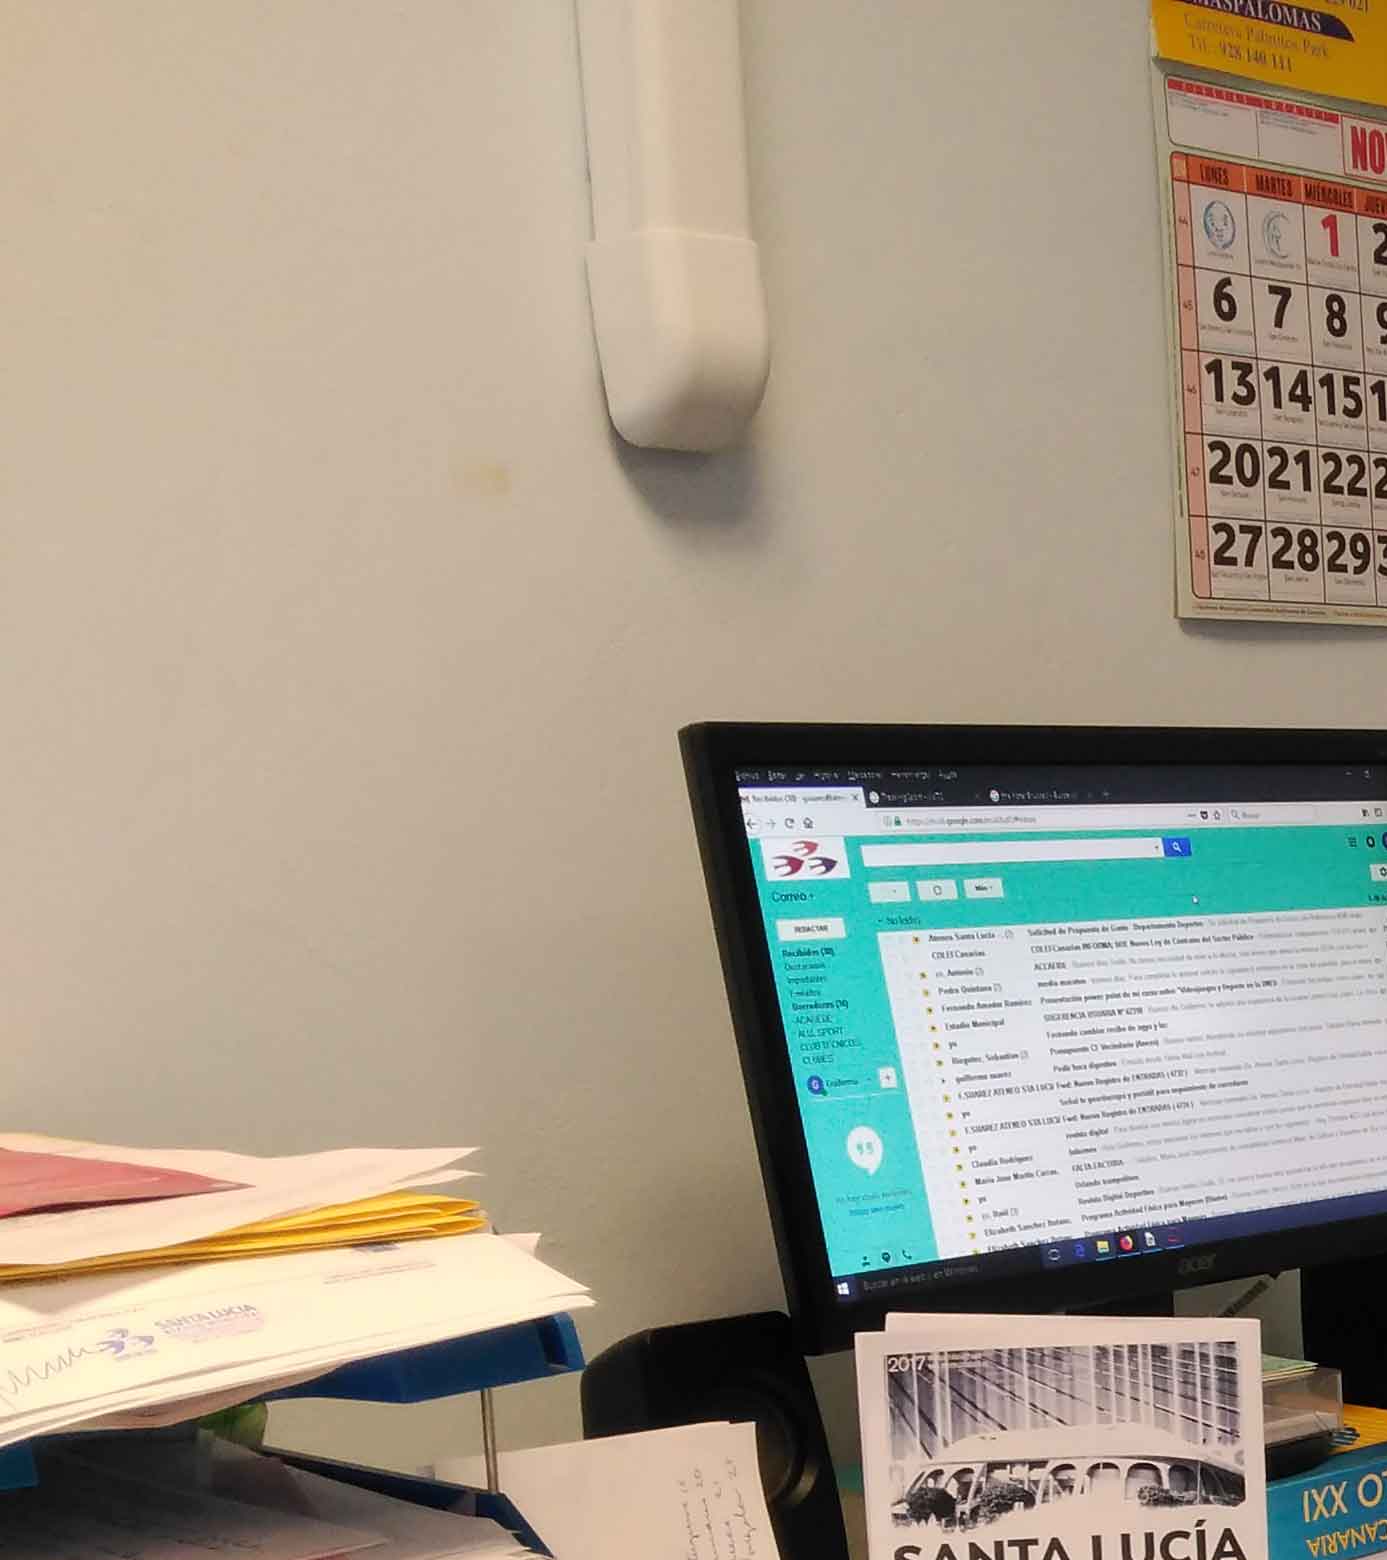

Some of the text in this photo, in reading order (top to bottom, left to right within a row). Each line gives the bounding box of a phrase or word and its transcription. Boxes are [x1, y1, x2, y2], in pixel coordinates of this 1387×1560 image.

[1200, 163, 1230, 186] LUNES
[1255, 174, 1293, 198] MARTES
[1321, 214, 1340, 257] 1
[1213, 277, 1237, 322] 6
[1268, 284, 1292, 329] 7
[1325, 293, 1348, 338] 8
[1204, 358, 1256, 406] 13
[1263, 366, 1313, 413] 14
[1318, 372, 1363, 418] 15
[1207, 440, 1261, 488] 20
[1266, 446, 1312, 492] 21
[1321, 451, 1368, 497] 22
[1212, 522, 1263, 568] 27
[1270, 526, 1320, 572] 28
[1326, 530, 1371, 576] 29
[887, 1355, 929, 1374] 2017
[1302, 1481, 1349, 1523] XXI
